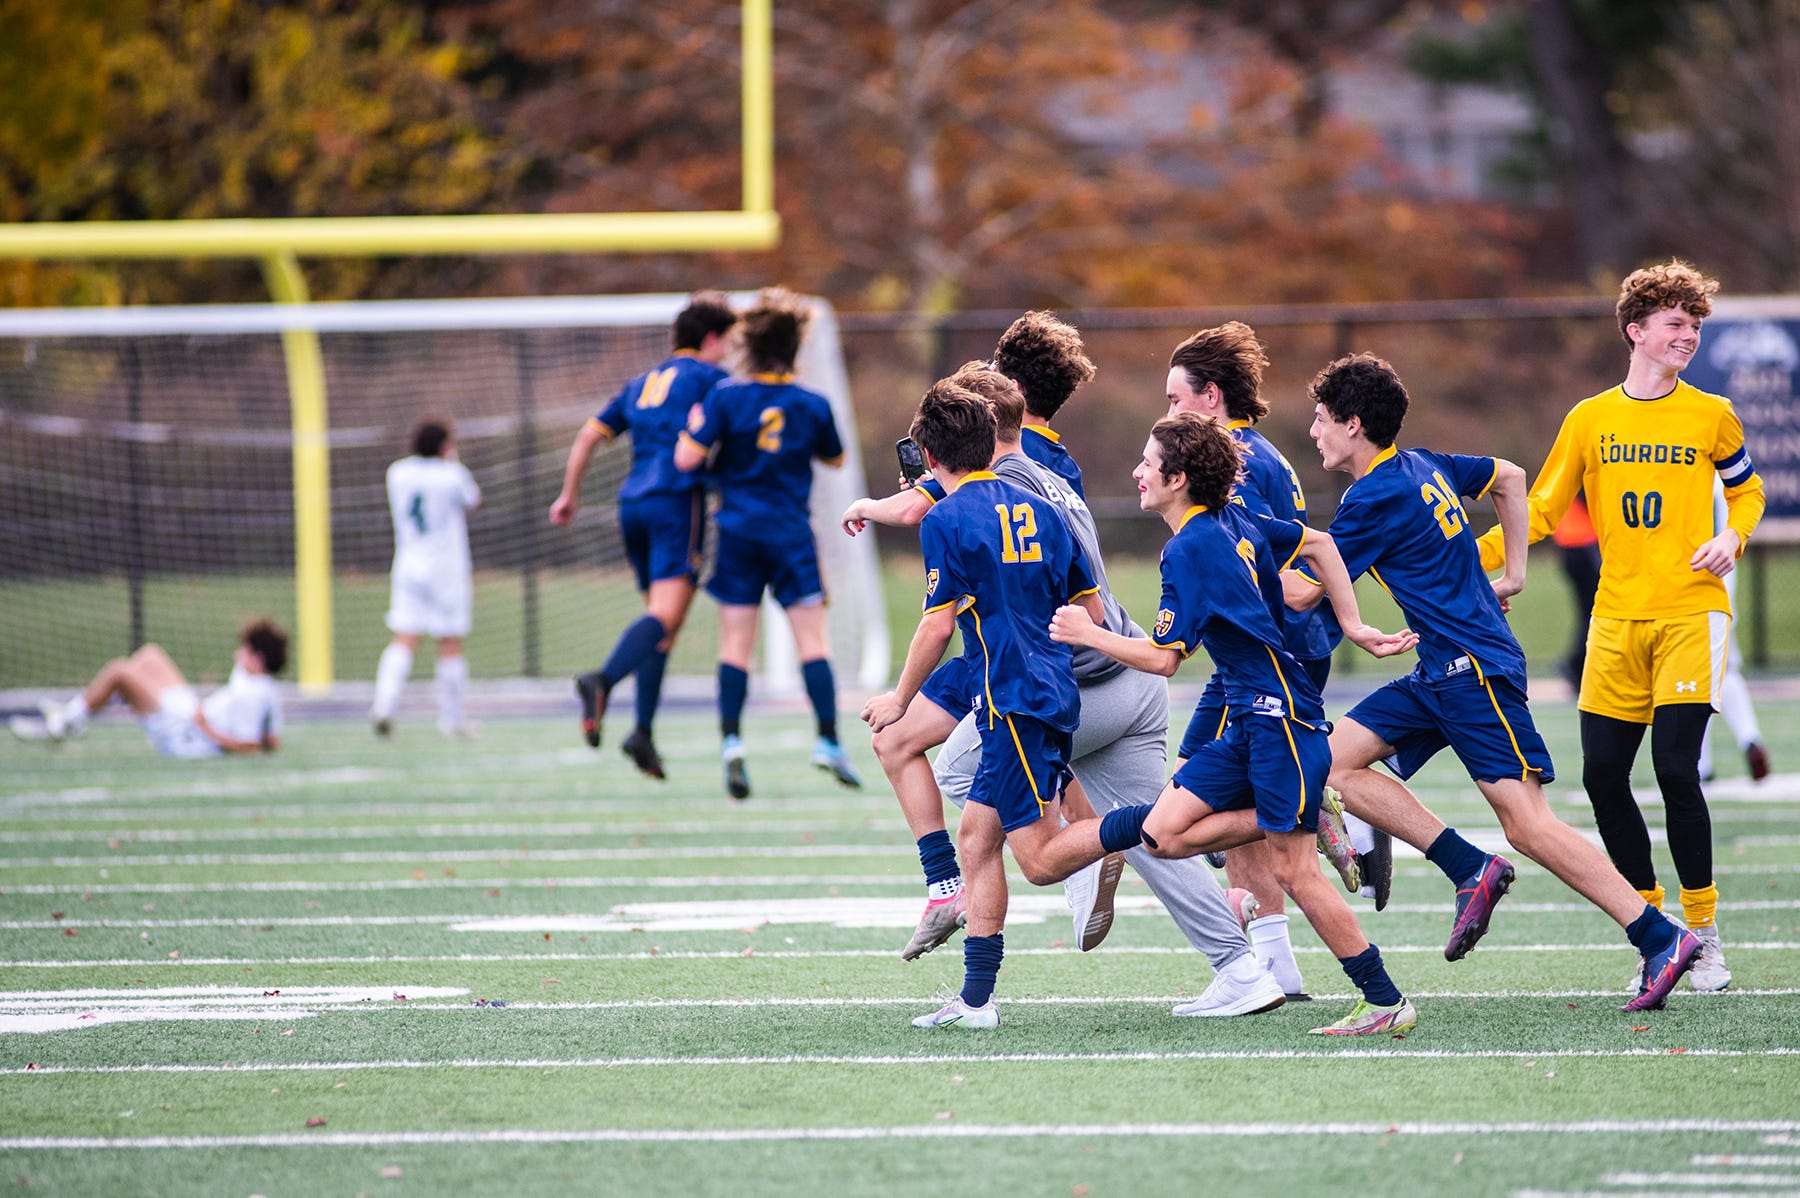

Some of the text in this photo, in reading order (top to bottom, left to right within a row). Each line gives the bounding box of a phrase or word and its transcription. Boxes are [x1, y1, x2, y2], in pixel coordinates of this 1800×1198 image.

[757, 406, 785, 453] 2
[1600, 443, 1697, 465] LOURDES
[1420, 470, 1470, 541] 24
[1621, 491, 1662, 528] 00
[995, 503, 1043, 563] 12
